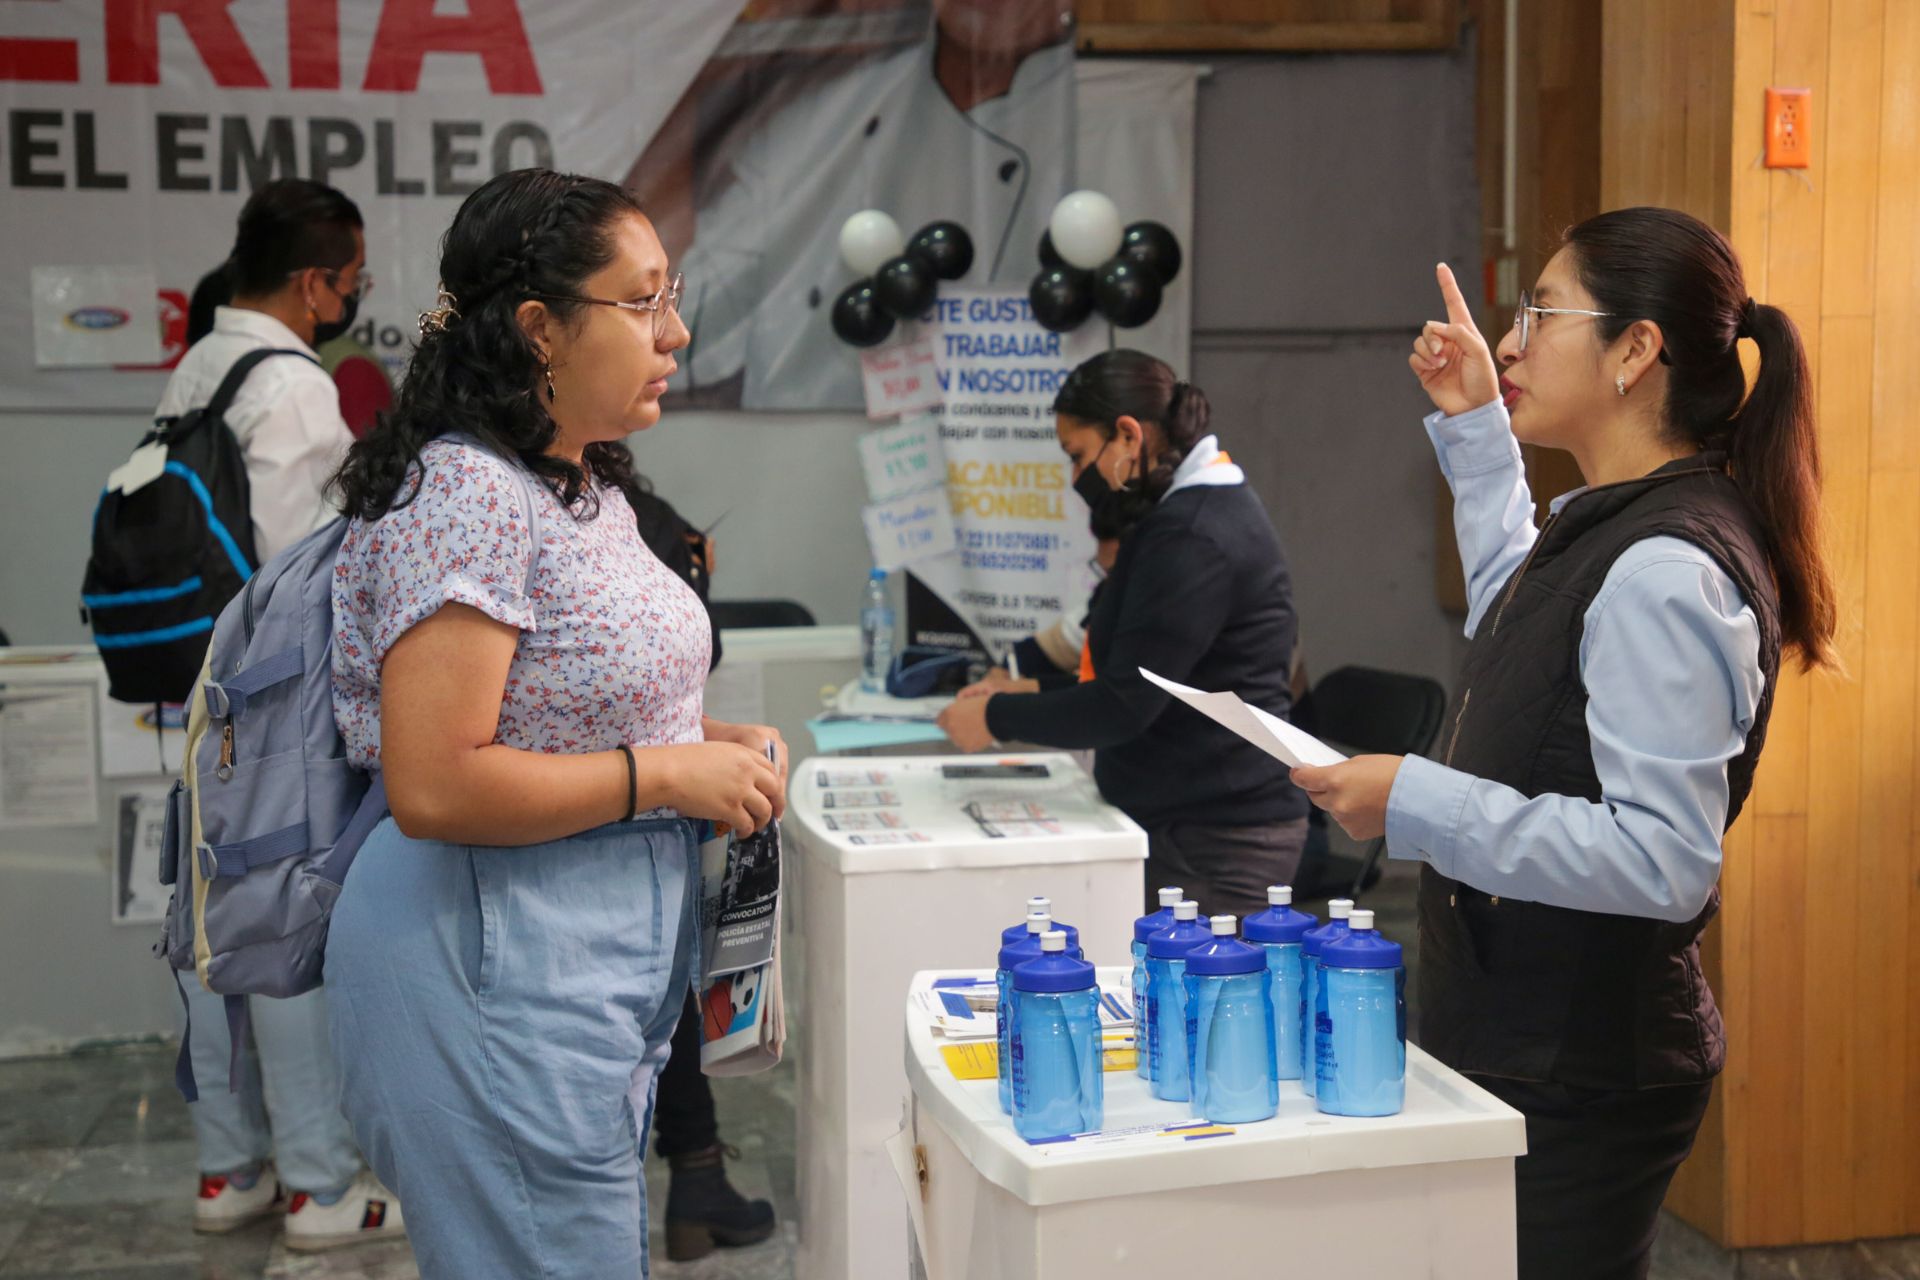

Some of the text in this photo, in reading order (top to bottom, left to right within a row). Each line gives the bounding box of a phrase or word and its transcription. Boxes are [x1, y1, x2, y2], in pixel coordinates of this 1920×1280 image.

[0, 109, 555, 197] EL EMPLEO
[968, 298, 1037, 323] GUST
[943, 333, 1061, 358] TRABAJAR
[721, 902, 773, 922] CONVOCATORIA
[722, 932, 764, 948] PREVENTIVA
